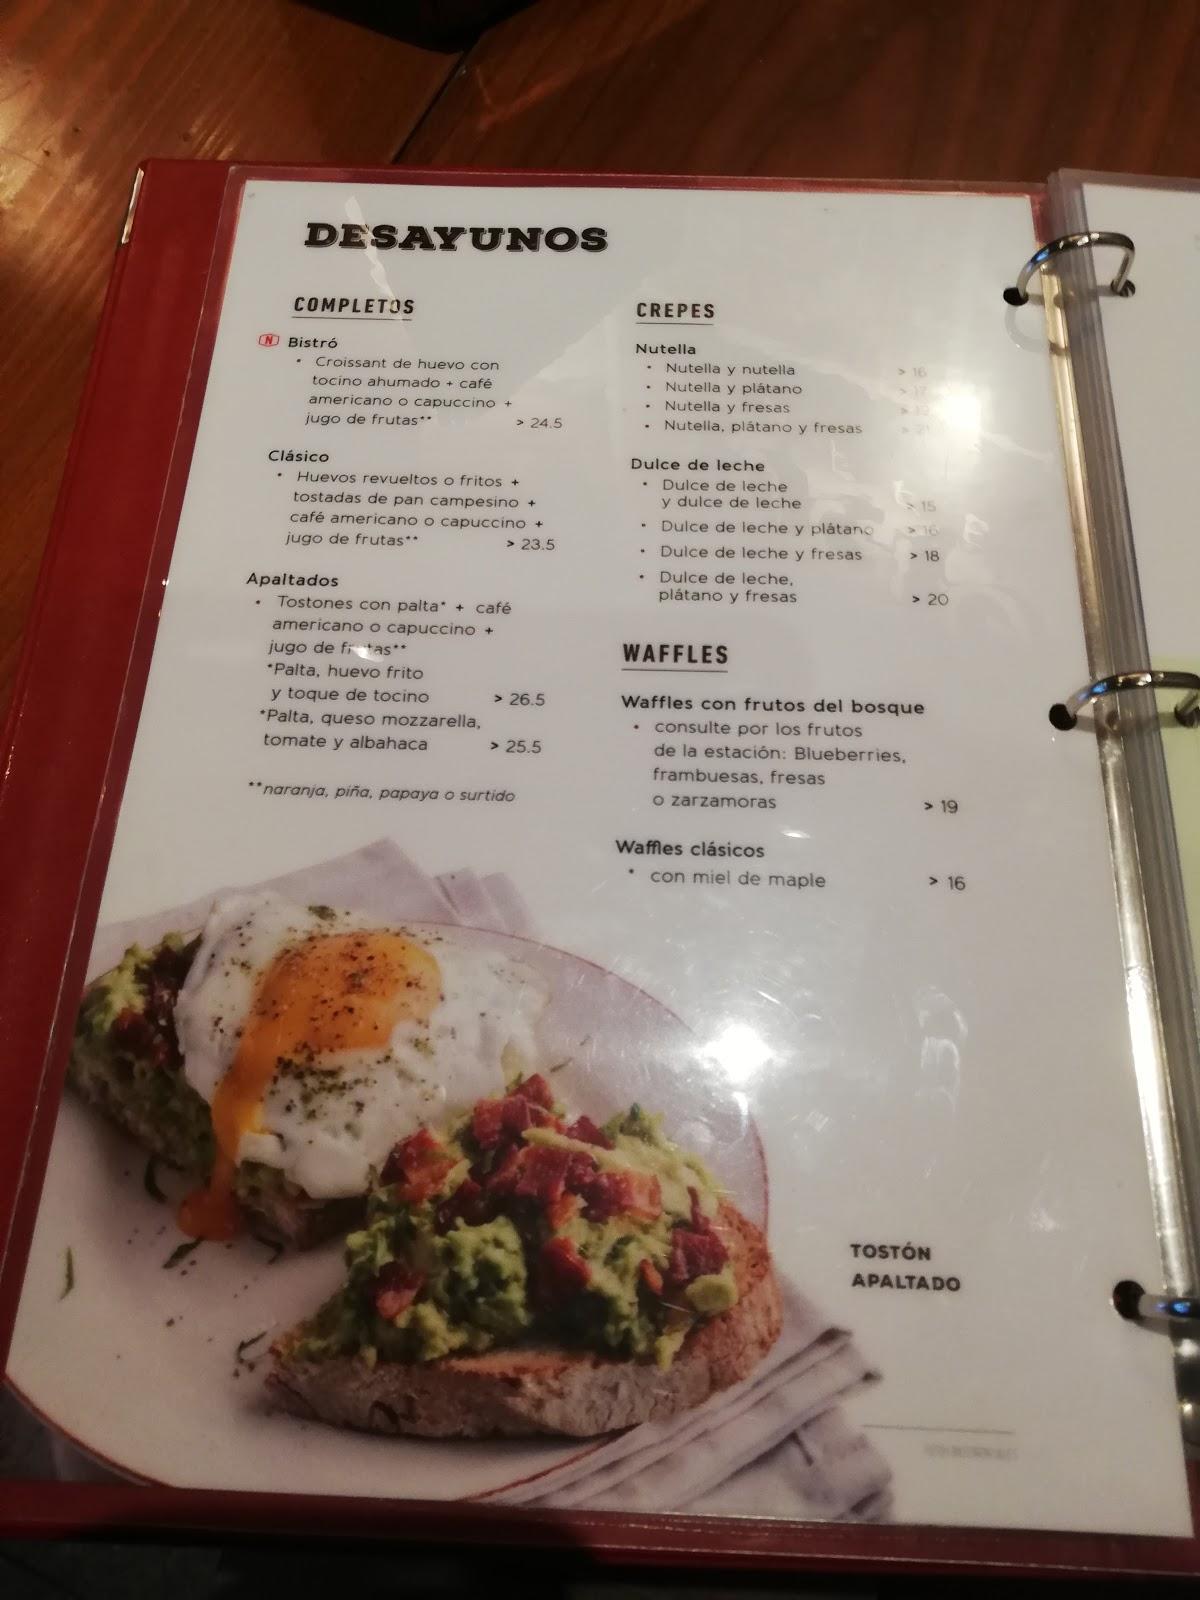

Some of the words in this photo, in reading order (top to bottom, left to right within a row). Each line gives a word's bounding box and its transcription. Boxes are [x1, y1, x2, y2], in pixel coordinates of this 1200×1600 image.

[304, 223, 608, 252] DESAYUNOS
[294, 297, 414, 314] COMPLETOS
[637, 303, 714, 318] CREPES
[288, 337, 337, 348] Bistró
[636, 344, 696, 354] Nutella
[316, 357, 386, 368] Croissant
[393, 358, 411, 368] de
[418, 359, 464, 369] huevo
[471, 362, 499, 370] con
[667, 363, 720, 374] Nutella
[728, 367, 735, 376] y
[743, 365, 795, 375] nutella
[913, 367, 927, 378] 16
[313, 376, 361, 386] tocino
[368, 377, 440, 388] ahumado
[460, 378, 492, 389] café
[666, 382, 720, 392] Nutella
[728, 385, 735, 395] y
[743, 383, 802, 395] plátano
[309, 396, 392, 405] americano
[399, 398, 408, 406] o
[414, 399, 495, 408] capuccino
[666, 401, 720, 412] Nutella
[727, 405, 735, 414] y
[742, 402, 790, 413] fresas
[305, 415, 340, 425] jugo
[347, 414, 365, 424] de
[531, 418, 562, 428] 24.5
[665, 420, 724, 432] Nutella,
[732, 421, 792, 433] plátano
[799, 425, 807, 435] y
[814, 422, 862, 433] fresas
[269, 450, 329, 462] Clásico
[632, 458, 680, 470] Dulce
[688, 459, 709, 470] de
[717, 460, 764, 471] leche
[297, 472, 356, 483] Huevos
[363, 474, 437, 485] revueltos
[444, 477, 454, 485] o
[460, 475, 502, 487] fritos
[663, 479, 709, 491] Dulce
[716, 481, 735, 491] de
[743, 481, 788, 492] leche
[294, 492, 361, 503] tostadas
[368, 493, 387, 504] de
[394, 496, 423, 506] pan
[431, 497, 518, 508] campesino
[662, 498, 671, 509] y
[678, 496, 722, 507] dulce
[730, 497, 749, 508] de
[756, 497, 801, 509] leche
[921, 500, 936, 512] 15
[290, 511, 324, 523] café
[331, 515, 417, 525] americano
[424, 518, 434, 526] o
[441, 518, 526, 529] capuccino
[662, 520, 708, 532] Dulce
[716, 522, 735, 533] de
[743, 522, 788, 533] leche
[795, 526, 804, 536] y
[812, 523, 874, 536] plátano
[923, 525, 940, 536] 16
[285, 535, 322, 546] jugo
[329, 533, 349, 544] de
[521, 539, 555, 550] 23.5
[661, 545, 708, 558] Dulce
[715, 546, 735, 558] de
[742, 547, 788, 559] leche
[795, 551, 804, 561] y
[812, 548, 862, 560] fresas
[925, 551, 939, 562] 18
[246, 573, 338, 587] Apaltados
[660, 571, 707, 583] Dulce
[715, 572, 735, 584] de
[743, 572, 793, 586] leche,
[278, 595, 352, 609] Tostones
[360, 600, 390, 610] con
[476, 601, 511, 614] café
[659, 589, 723, 602] plátano
[730, 593, 738, 604] y
[746, 590, 797, 602] fresas
[928, 593, 948, 606] 20
[272, 620, 363, 632] americano
[370, 623, 381, 632] o
[387, 623, 475, 636] capuccino
[268, 643, 307, 655] jugo
[314, 641, 335, 654] de
[341, 642, 407, 655] frtas
[623, 644, 727, 664] WAFFLES
[328, 664, 380, 678] huevo
[387, 666, 423, 679] frito
[272, 689, 281, 701] y
[288, 688, 339, 702] toque
[346, 689, 367, 701] de
[374, 690, 429, 703] tocino
[510, 693, 545, 706] 26.5
[621, 696, 692, 709] Waffles
[701, 700, 736, 710] con
[744, 698, 805, 712] frutos
[814, 699, 842, 712] del
[852, 700, 924, 716] bosque
[321, 714, 375, 726] queso
[382, 714, 480, 729] mozzarella,
[655, 721, 731, 734] consulte
[738, 725, 768, 736] por
[776, 722, 800, 736] los
[808, 723, 862, 737] frutos
[264, 734, 326, 747] tomate
[333, 738, 344, 750] y
[350, 736, 427, 750] albahaca
[506, 740, 541, 753] 25.5
[654, 744, 676, 757] de
[683, 744, 697, 757] la
[704, 746, 785, 759] estación:
[795, 747, 905, 763] Blueberries,
[654, 767, 763, 784] frambuesas,
[771, 771, 825, 785] fresas
[334, 785, 372, 799] piña,
[379, 789, 439, 801] papaya
[444, 791, 455, 800] o
[460, 790, 515, 802] surtido
[653, 795, 664, 806] o
[672, 796, 776, 809] zarzamoras
[941, 800, 958, 814] 19
[616, 840, 683, 855] Waffles
[690, 842, 764, 857] clásicos
[651, 872, 685, 883] con
[693, 871, 730, 884] miel
[738, 871, 760, 886] de
[769, 873, 826, 890] maple
[948, 876, 966, 891] 16
[850, 1242, 931, 1261] TOSTÓN
[852, 1273, 960, 1292] APALTADO
